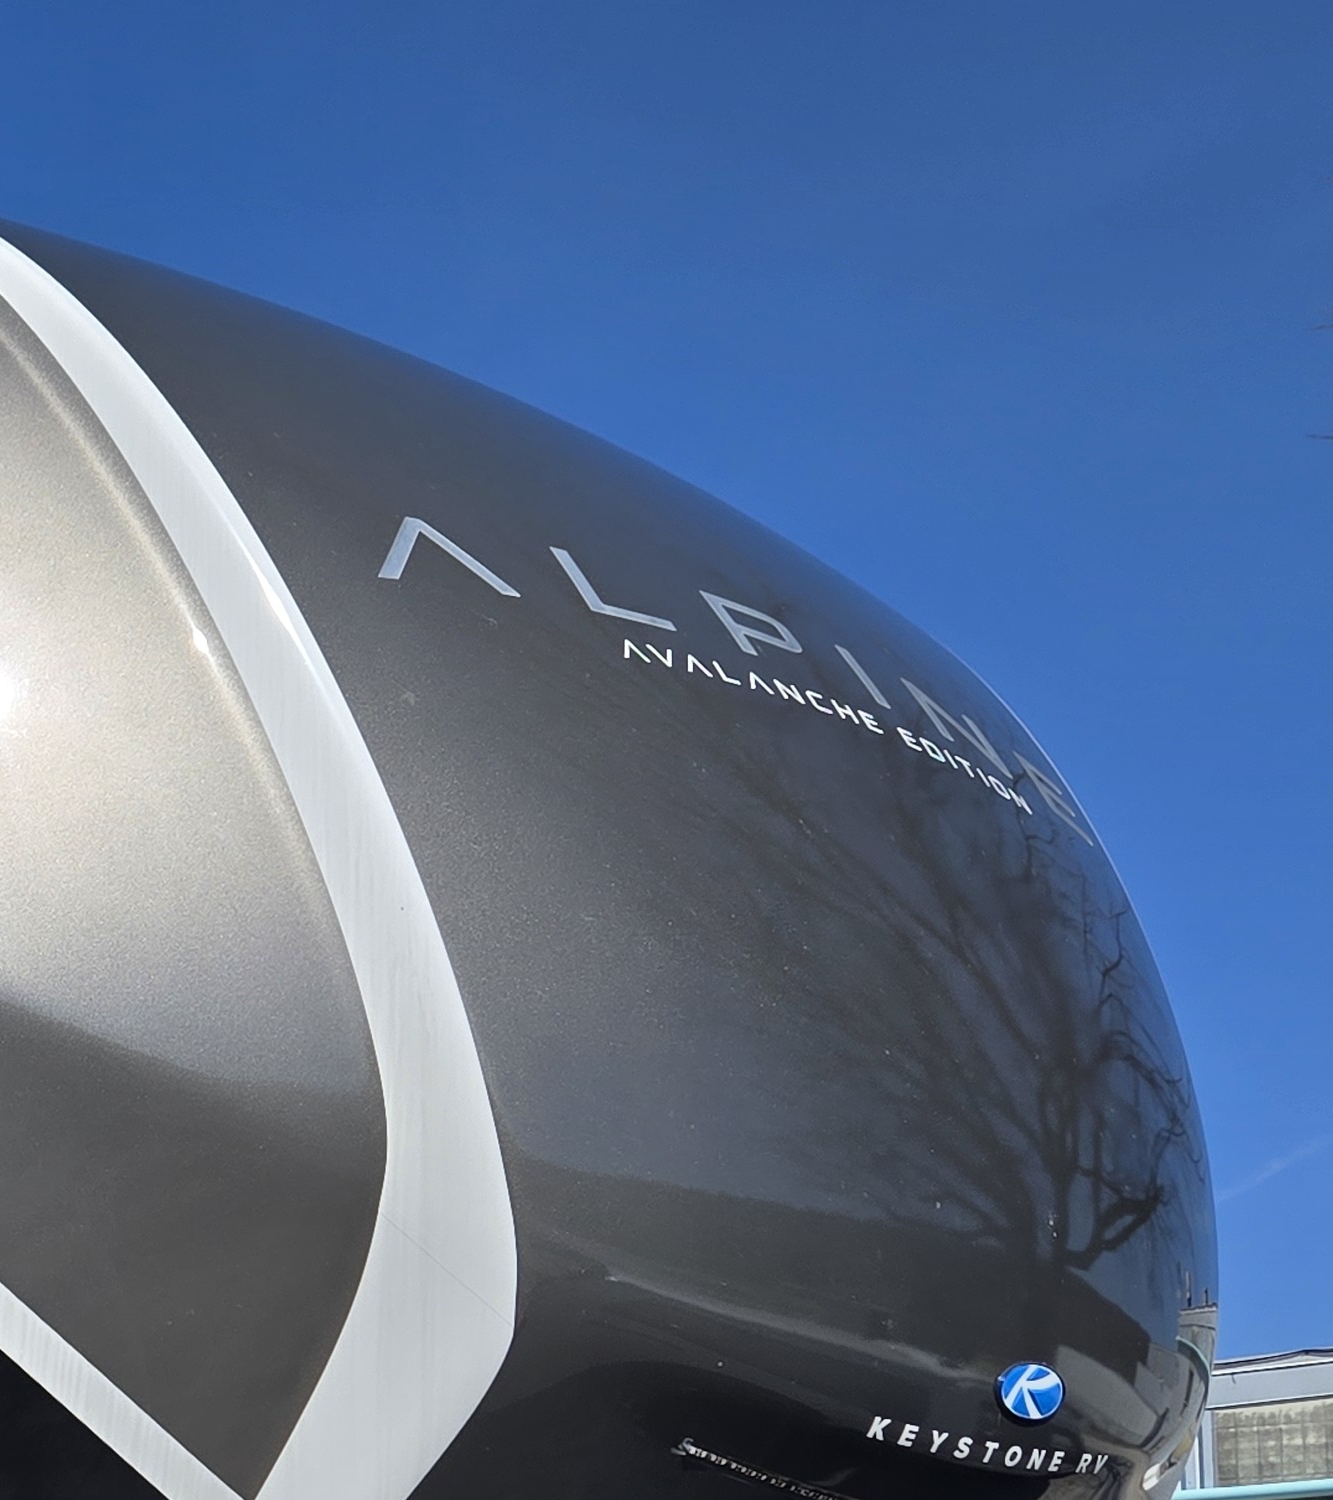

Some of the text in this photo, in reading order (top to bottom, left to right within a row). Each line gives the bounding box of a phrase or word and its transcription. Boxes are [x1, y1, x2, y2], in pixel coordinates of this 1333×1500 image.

[377, 515, 1094, 847] ALPINE
[623, 638, 1033, 815] AVALANCHE EDITION
[865, 1415, 1109, 1475] KEYSTONE RV
